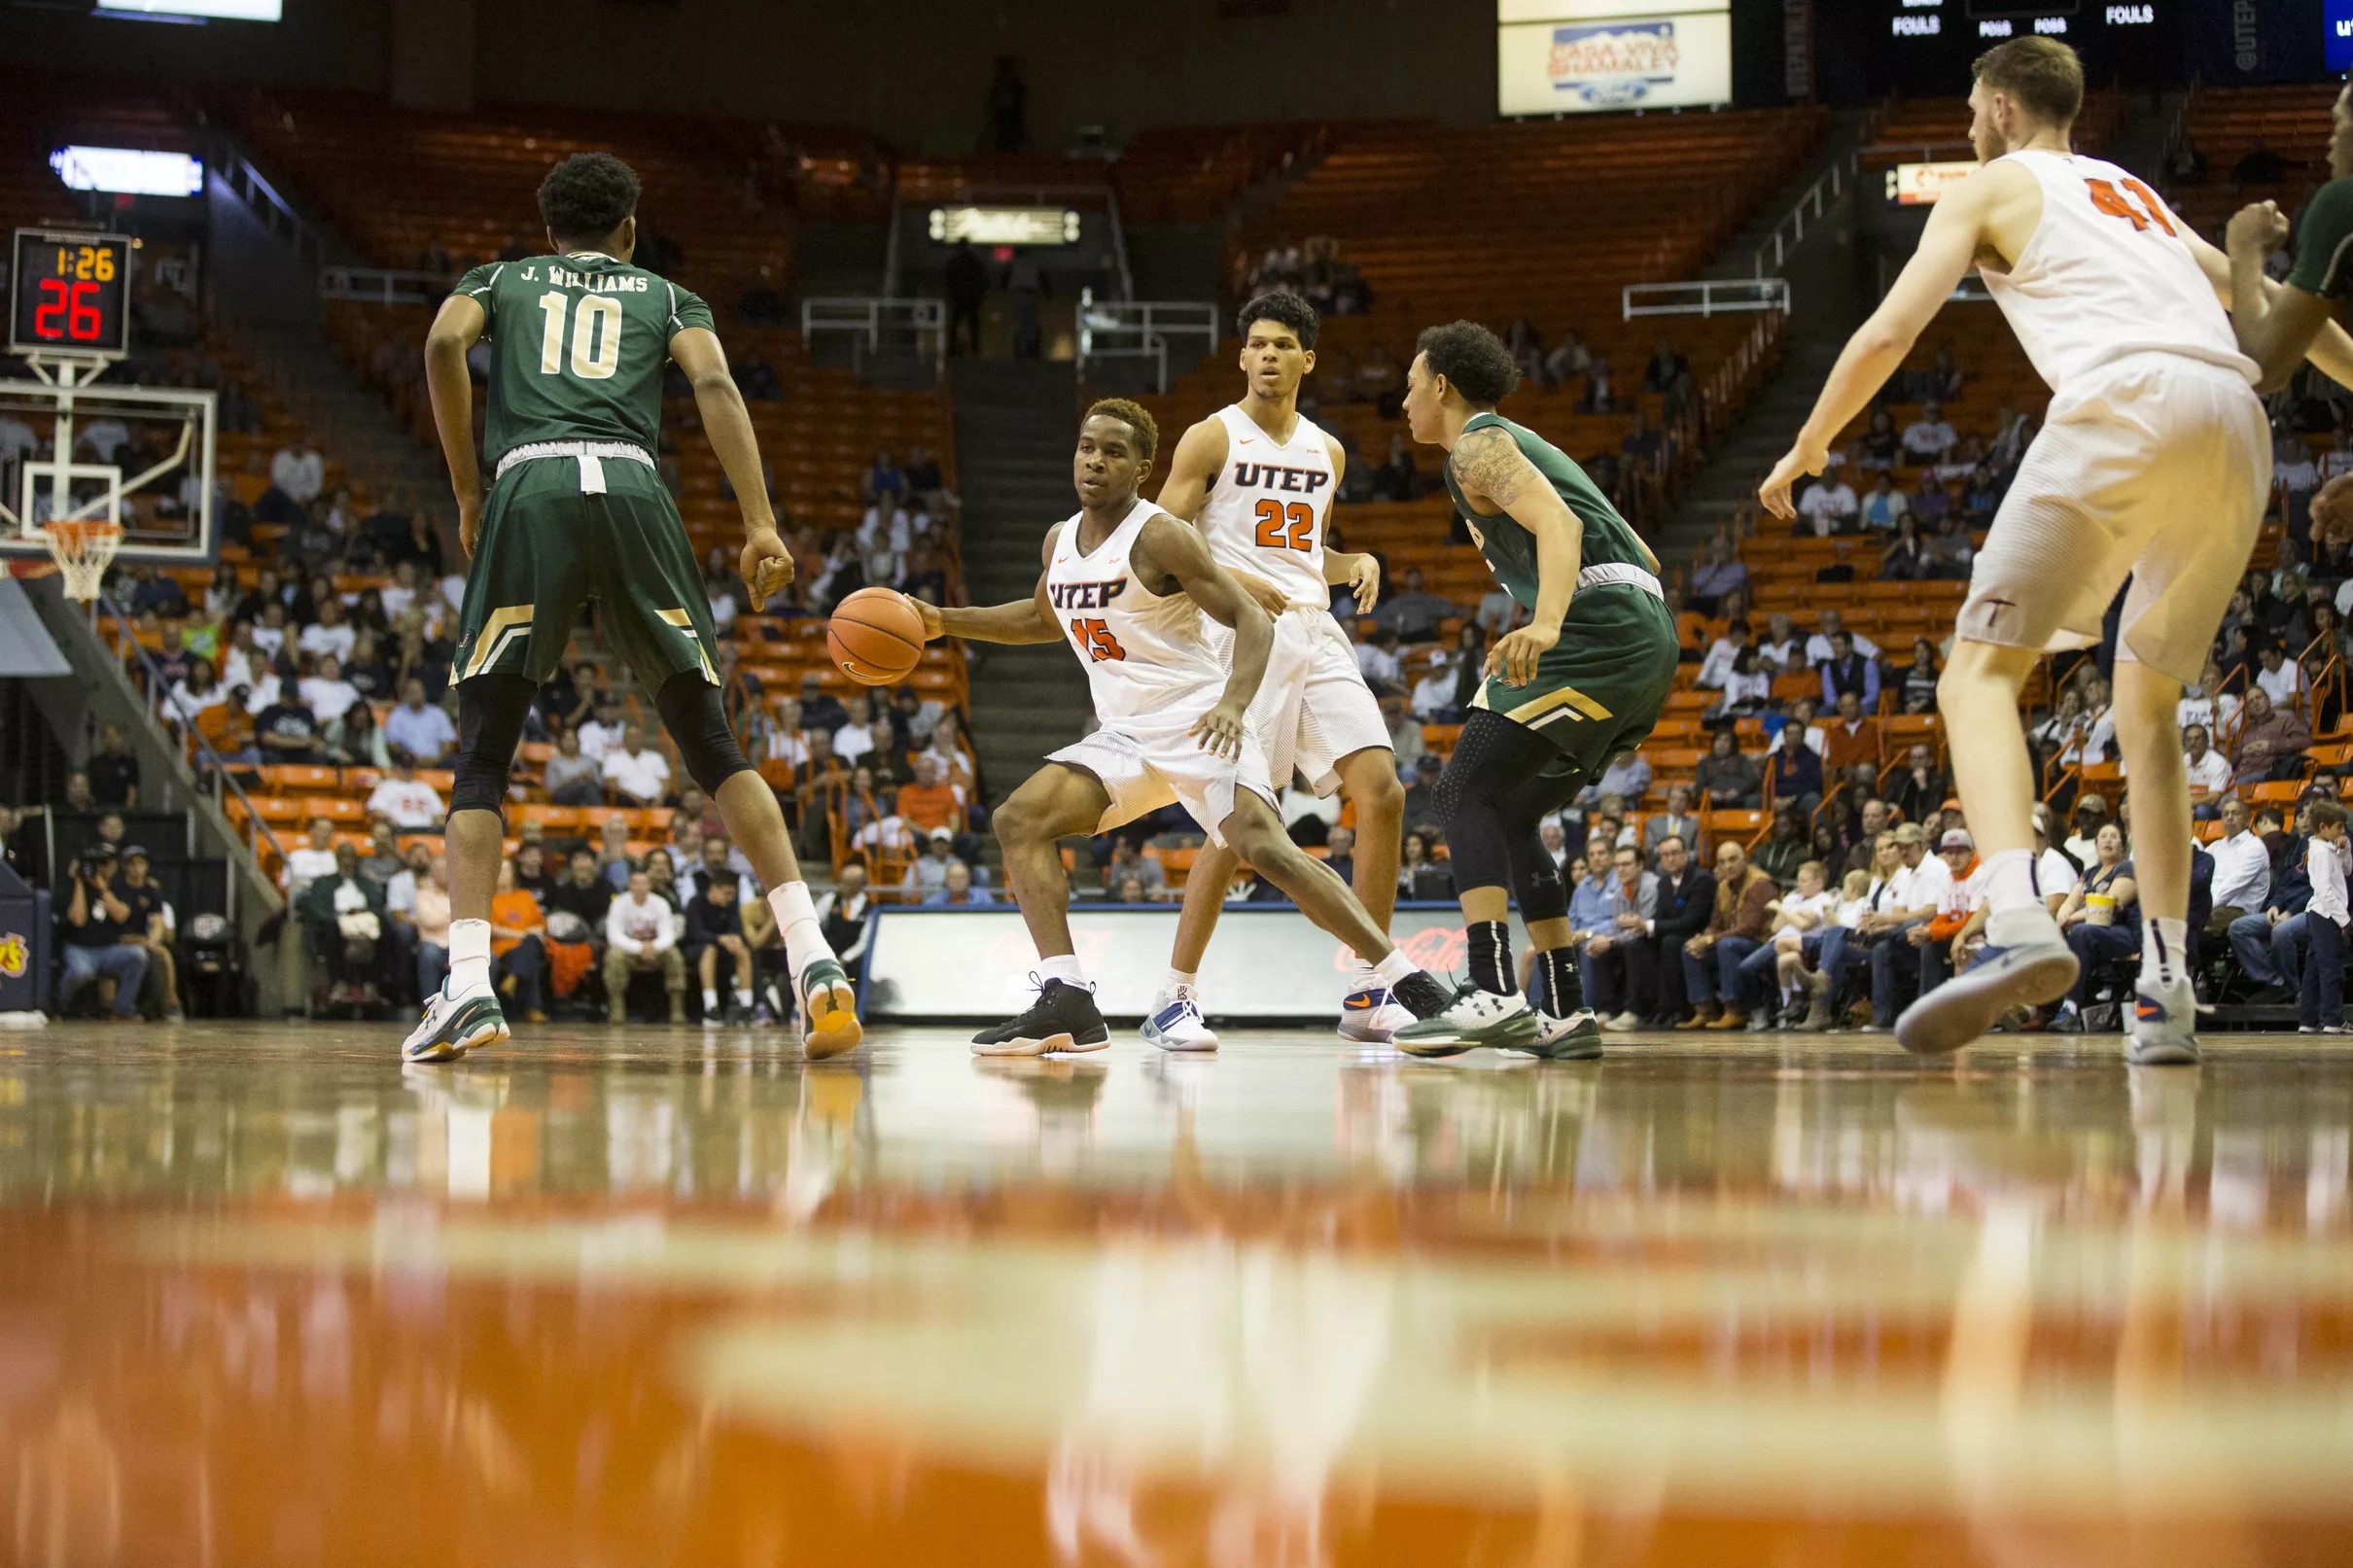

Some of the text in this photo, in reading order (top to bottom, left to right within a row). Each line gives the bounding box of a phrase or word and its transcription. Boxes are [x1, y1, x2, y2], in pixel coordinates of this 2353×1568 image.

[1892, 15, 1941, 36] FOULS
[2106, 5, 2154, 24] FOULS
[2084, 178, 2177, 237] 41
[57, 246, 115, 281] 1:26
[520, 265, 649, 294] J. WILLIAMS
[35, 278, 101, 340] 26
[539, 290, 622, 379] 10
[1235, 462, 1328, 493] UTEP
[1255, 498, 1314, 552] 22
[1050, 576, 1128, 610] UTEP
[1071, 618, 1126, 663] 15
